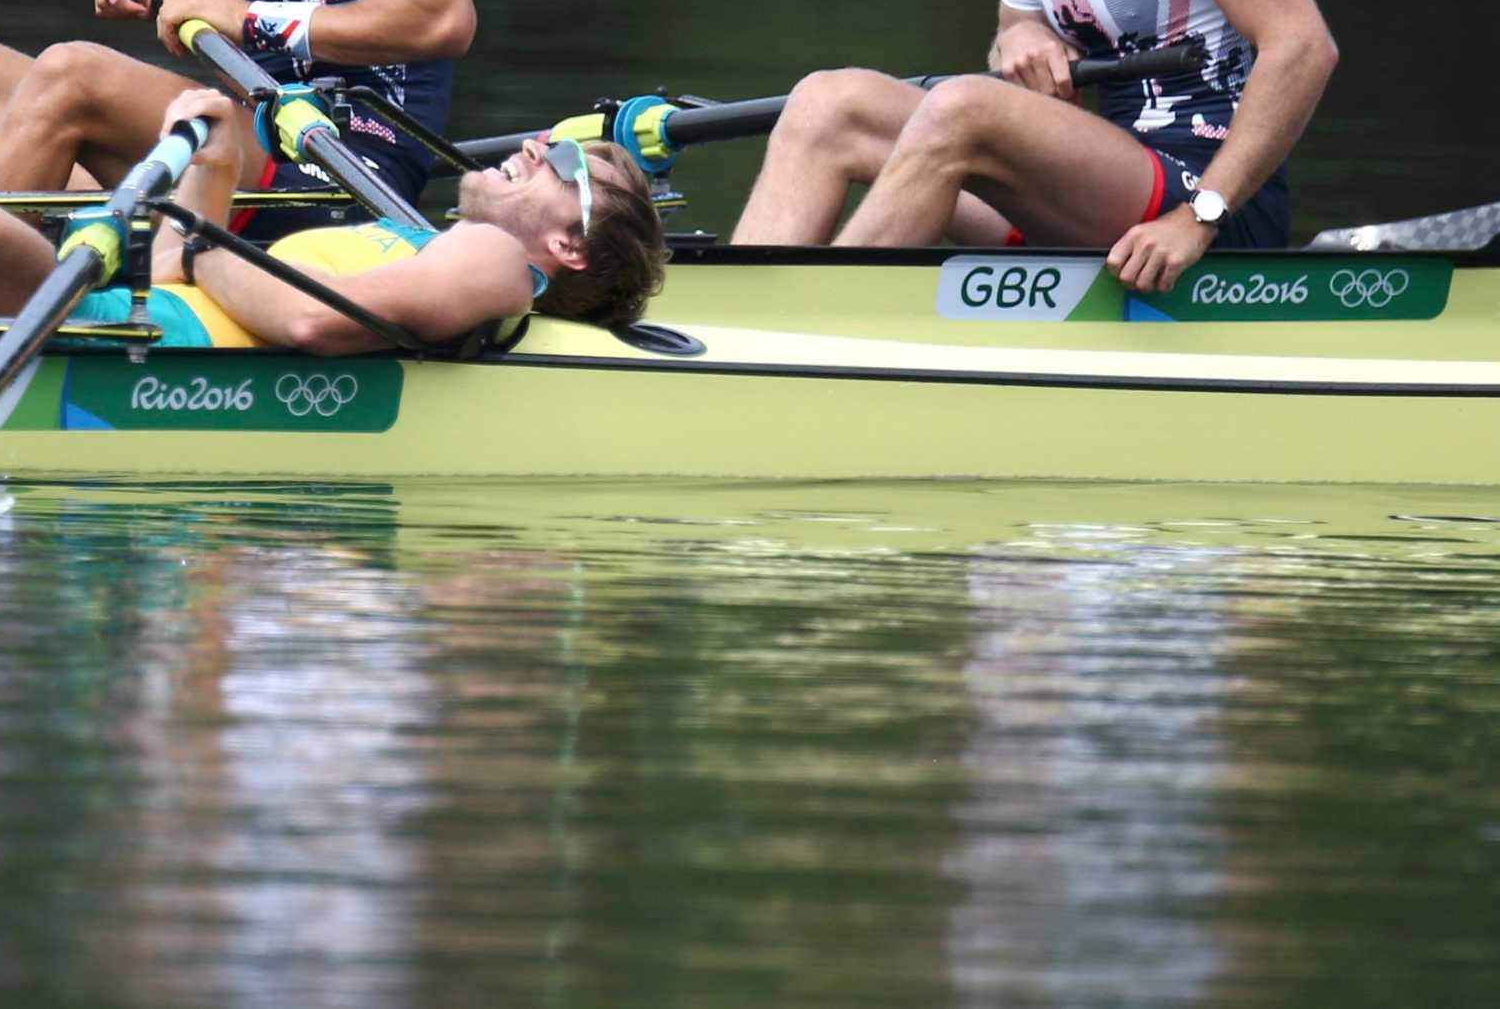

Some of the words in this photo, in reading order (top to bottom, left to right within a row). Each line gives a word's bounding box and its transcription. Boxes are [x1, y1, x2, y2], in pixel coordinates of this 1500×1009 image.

[960, 266, 1062, 309] GBR
[1191, 273, 1309, 304] Rio2016
[130, 375, 254, 411] Rio2016
